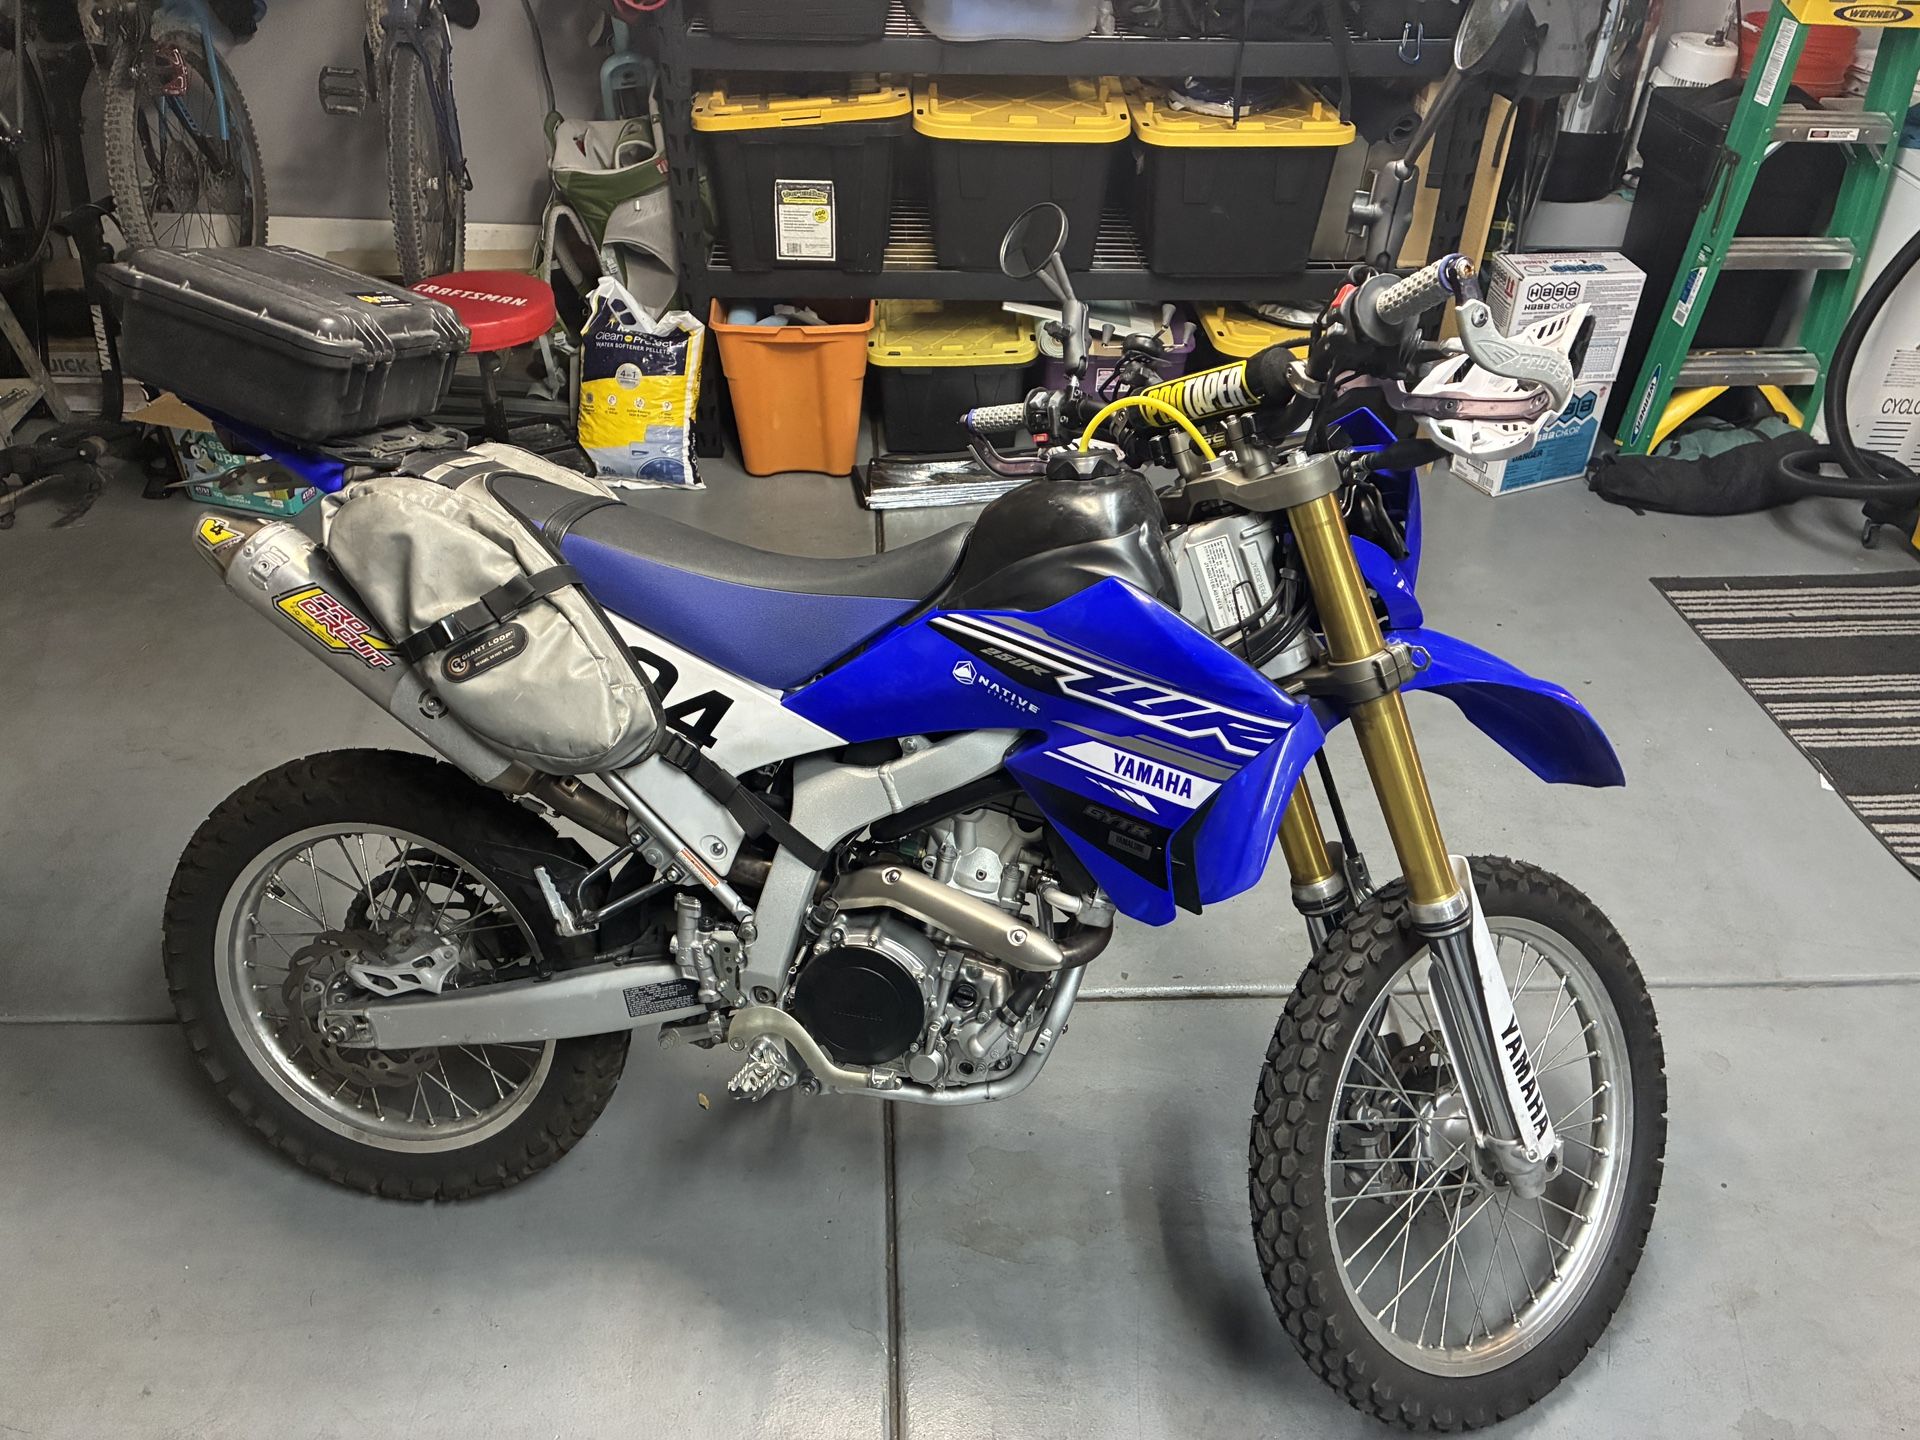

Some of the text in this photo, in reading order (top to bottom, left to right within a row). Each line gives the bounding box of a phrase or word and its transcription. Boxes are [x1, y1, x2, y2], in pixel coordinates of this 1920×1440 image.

[1849, 9, 1899, 19] WERNER
[413, 284, 528, 307] CRAFTSMAN
[595, 331, 624, 342] Clean
[615, 343, 644, 352] SOFTENER
[620, 370, 626, 378] 4
[311, 592, 371, 635] PRO
[297, 598, 395, 668] CIRCUIT
[461, 643, 486, 661] GIANT
[488, 630, 513, 647] LOOP
[979, 647, 1052, 677] 250R
[978, 674, 1041, 715] NATIVE
[1112, 752, 1193, 800] YAMAHA
[1082, 804, 1153, 840] GYTR
[1500, 1012, 1549, 1142] YAMAHA
